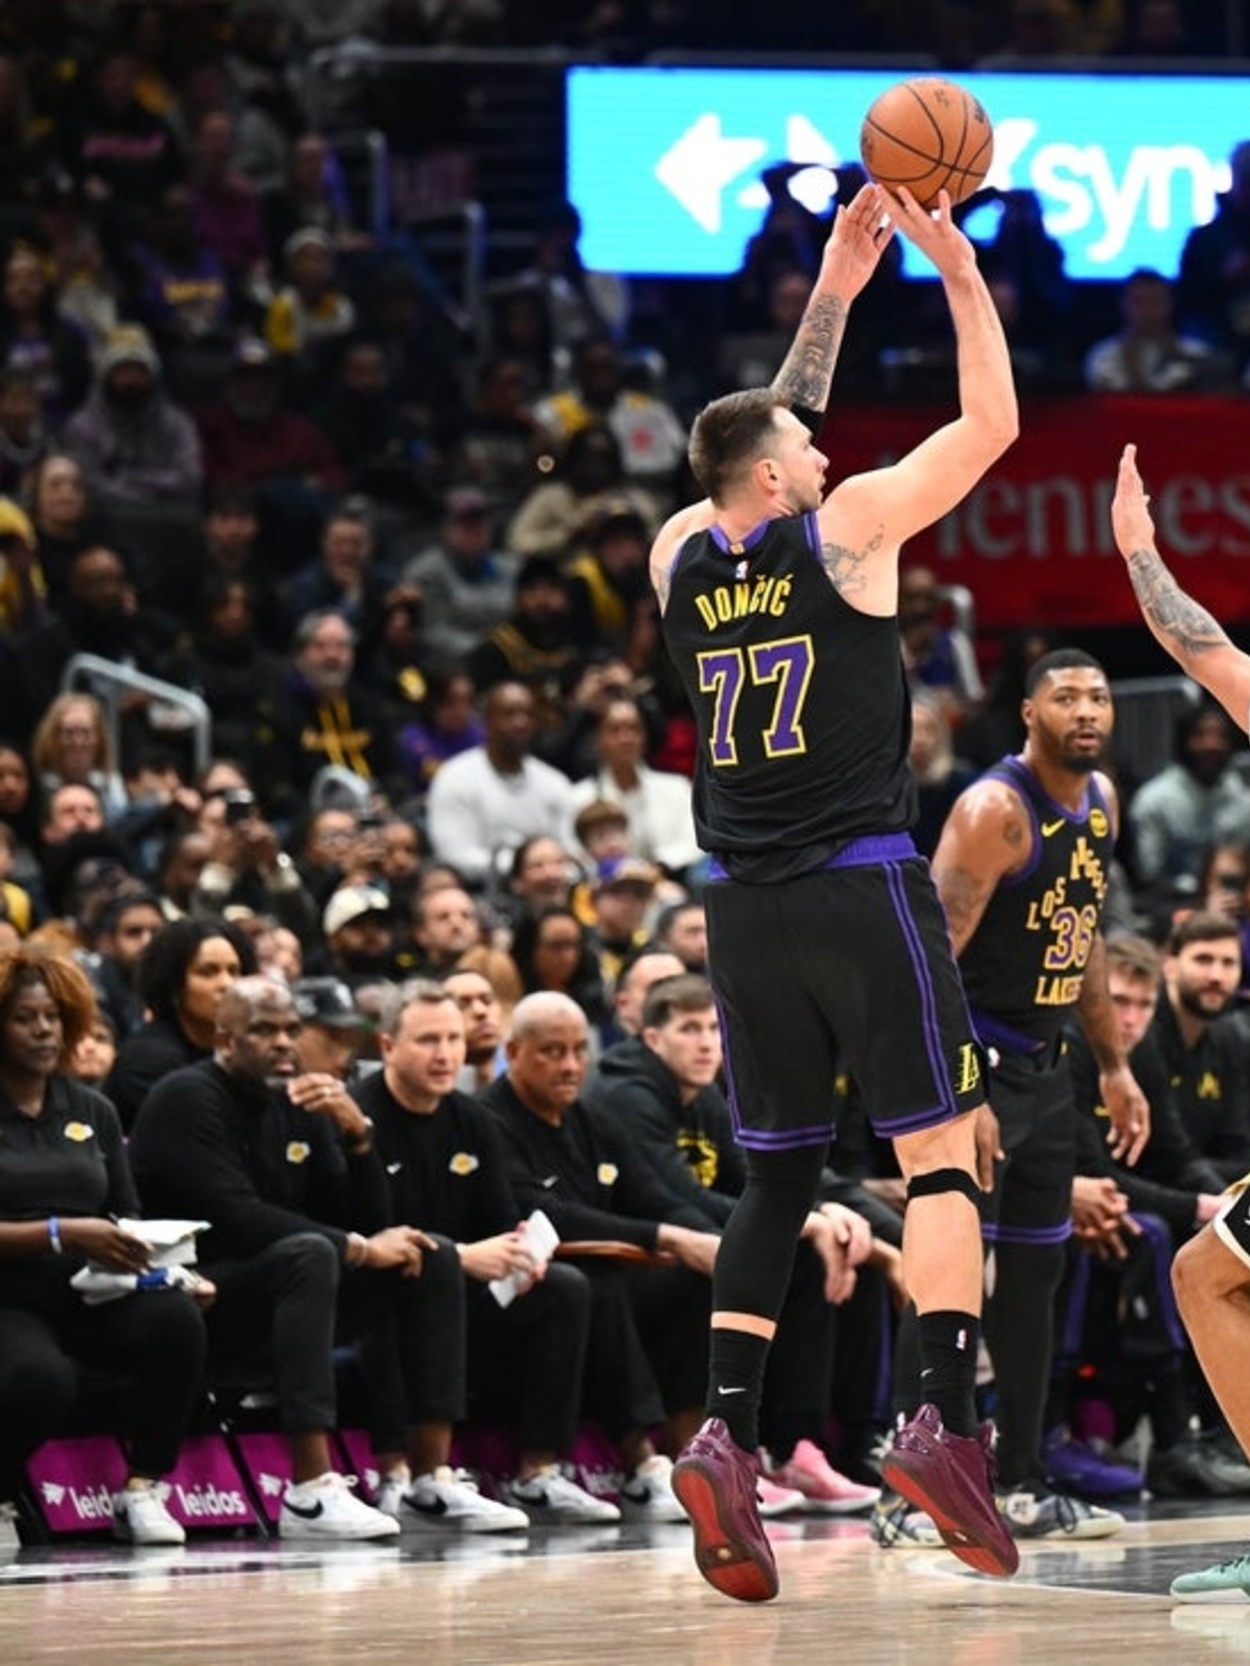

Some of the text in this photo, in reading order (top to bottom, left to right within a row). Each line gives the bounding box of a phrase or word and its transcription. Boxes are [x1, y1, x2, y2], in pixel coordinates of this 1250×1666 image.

[695, 574, 794, 631] DONČIĆ
[697, 634, 815, 766] 77
[1026, 876, 1066, 930] LOS
[1043, 904, 1098, 970] 36
[69, 1484, 116, 1518] leid
[176, 1483, 247, 1516] leidos
